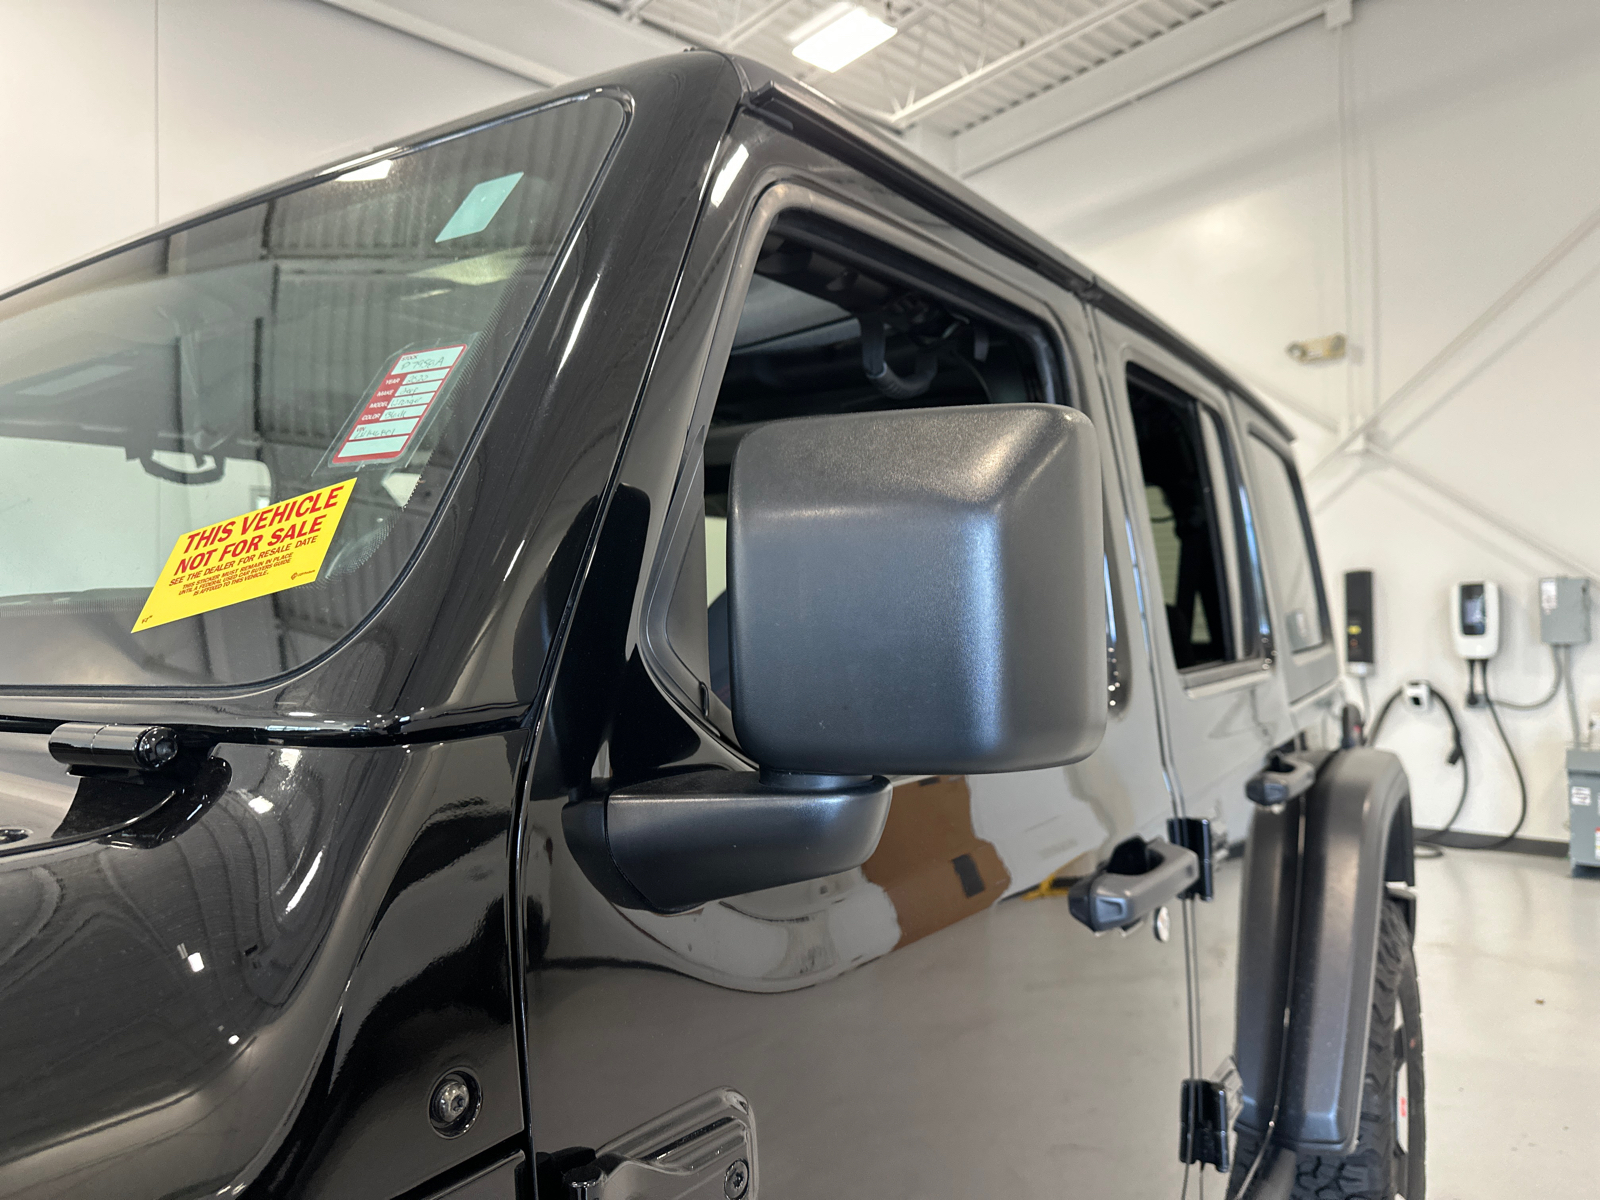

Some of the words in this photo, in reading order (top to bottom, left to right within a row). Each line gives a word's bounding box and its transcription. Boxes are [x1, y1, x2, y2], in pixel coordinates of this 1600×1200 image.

[369, 401, 388, 409] MODEL
[377, 389, 394, 397] MAKE
[362, 413, 380, 421] COLOR
[183, 521, 236, 554] THIS
[241, 485, 344, 535] VEHICLE
[169, 576, 185, 586] SEE
[187, 570, 203, 581] THE
[203, 560, 236, 576] DEALER
[237, 554, 256, 565] FOR
[258, 543, 292, 559] RESALE
[295, 535, 318, 548] DATE
[174, 548, 218, 576] NOT
[218, 534, 264, 562] FOR
[267, 514, 327, 546] SALE
[178, 587, 193, 596] UNTIL
[199, 579, 221, 589] FEDERAL
[223, 574, 238, 582] USED
[251, 563, 273, 574] BUYERS
[273, 558, 291, 567] GUIDE
[182, 581, 195, 590] THIS
[196, 574, 220, 585] STICKER
[221, 568, 239, 577] MUST
[240, 561, 264, 572] REMAIN
[273, 552, 293, 562] PLACE
[199, 584, 222, 594] AFFIXED
[231, 577, 244, 585] THIS
